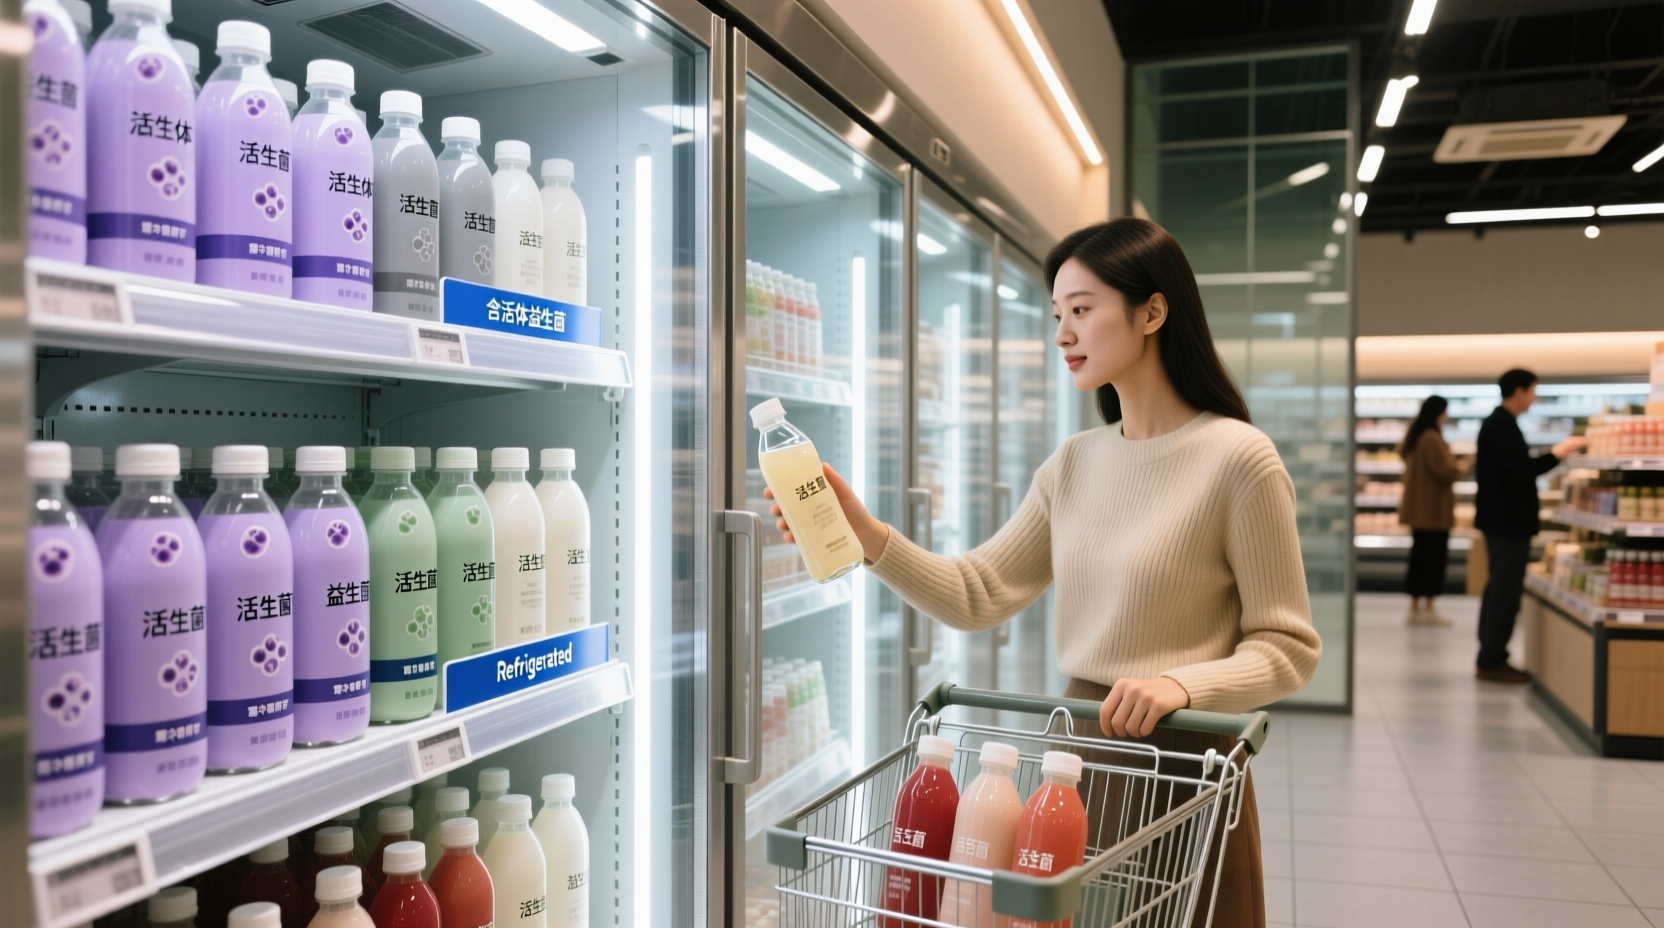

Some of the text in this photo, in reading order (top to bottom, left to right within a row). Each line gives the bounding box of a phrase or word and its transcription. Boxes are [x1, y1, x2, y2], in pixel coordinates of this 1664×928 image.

[130, 110, 193, 146] 活生体
[239, 140, 292, 173] 活生菌
[399, 194, 439, 219] 活生菌
[486, 296, 567, 333] 含活体益生菌
[325, 579, 370, 607] 益生菌
[394, 568, 438, 594] 活生菌
[142, 604, 207, 639] 活生菌
[236, 591, 293, 622] 活生菌
[497, 641, 573, 683] Refrigerated
